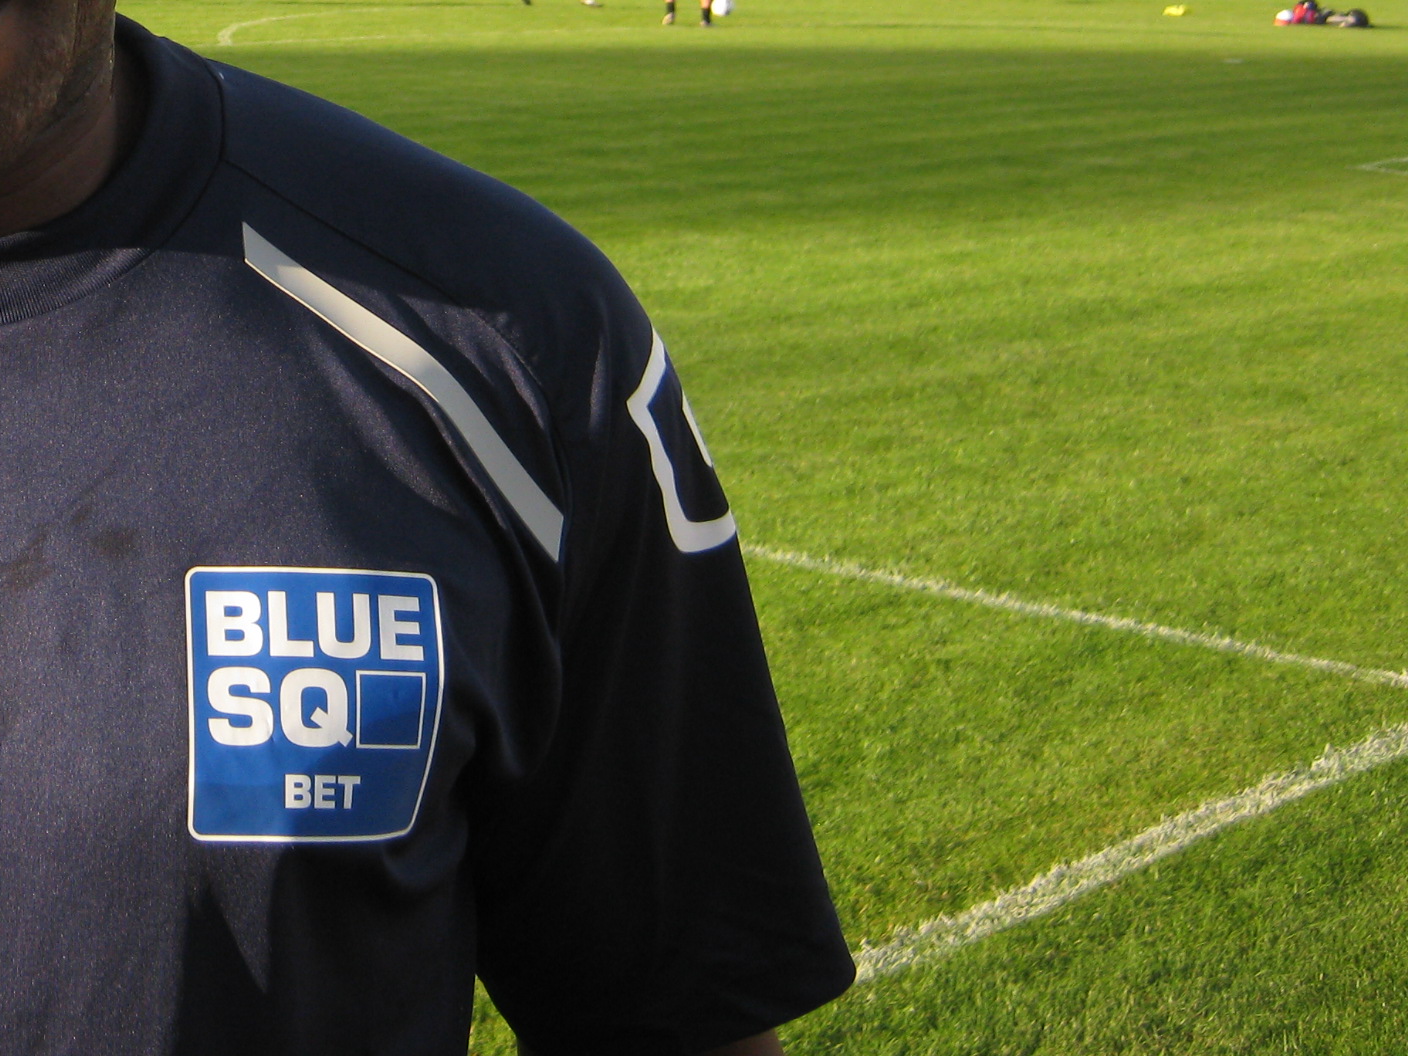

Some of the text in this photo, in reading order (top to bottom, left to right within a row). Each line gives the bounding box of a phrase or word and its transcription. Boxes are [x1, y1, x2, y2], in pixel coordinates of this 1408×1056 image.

[205, 590, 425, 661] BLUE
[207, 666, 353, 748] SQ
[284, 774, 361, 810] BET
